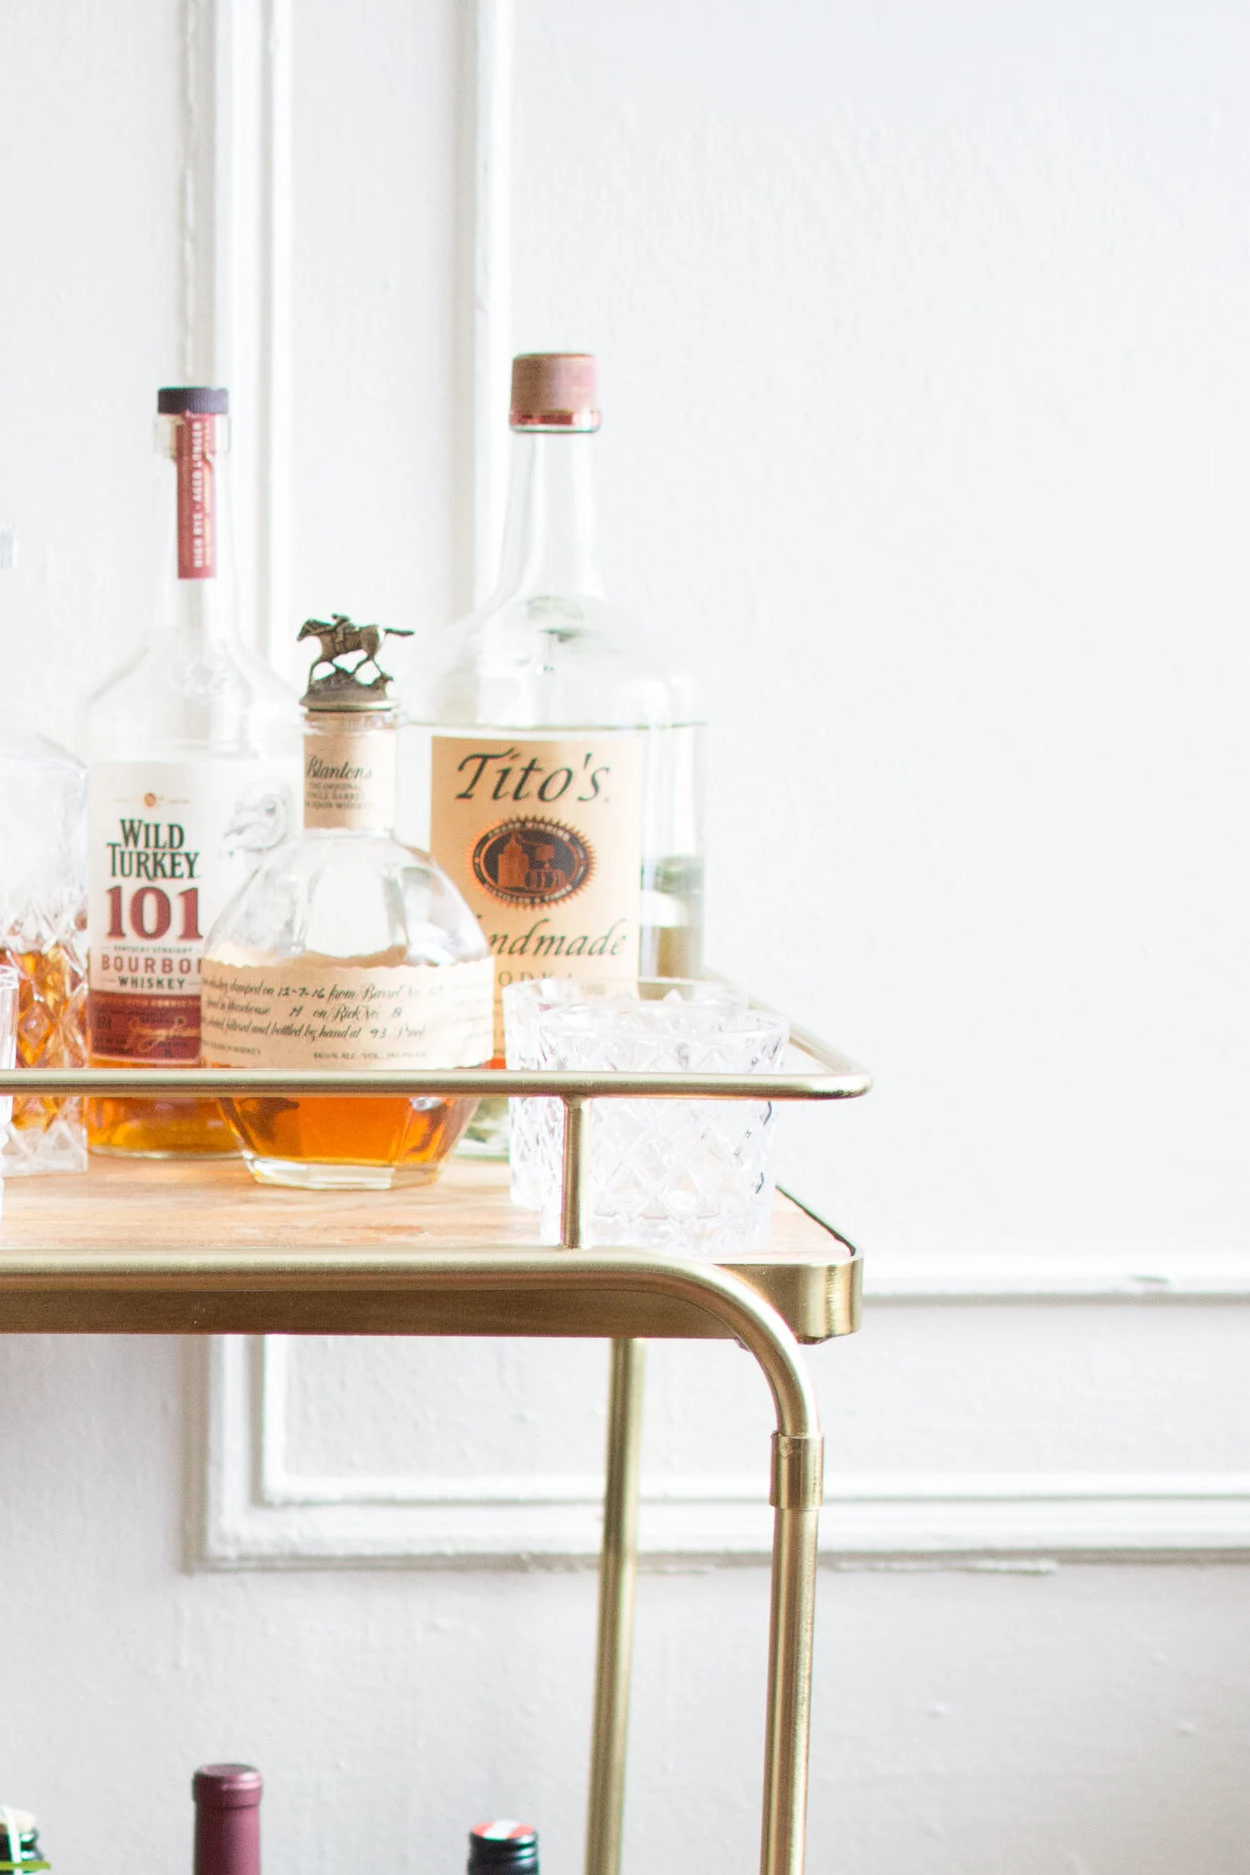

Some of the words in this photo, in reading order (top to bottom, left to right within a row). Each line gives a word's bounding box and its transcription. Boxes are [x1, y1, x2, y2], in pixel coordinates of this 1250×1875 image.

[454, 747, 611, 803] Tito's
[119, 818, 186, 851] WILD
[106, 841, 201, 882] TURKEY
[105, 885, 204, 941] 101
[118, 975, 186, 990] WHISKEY
